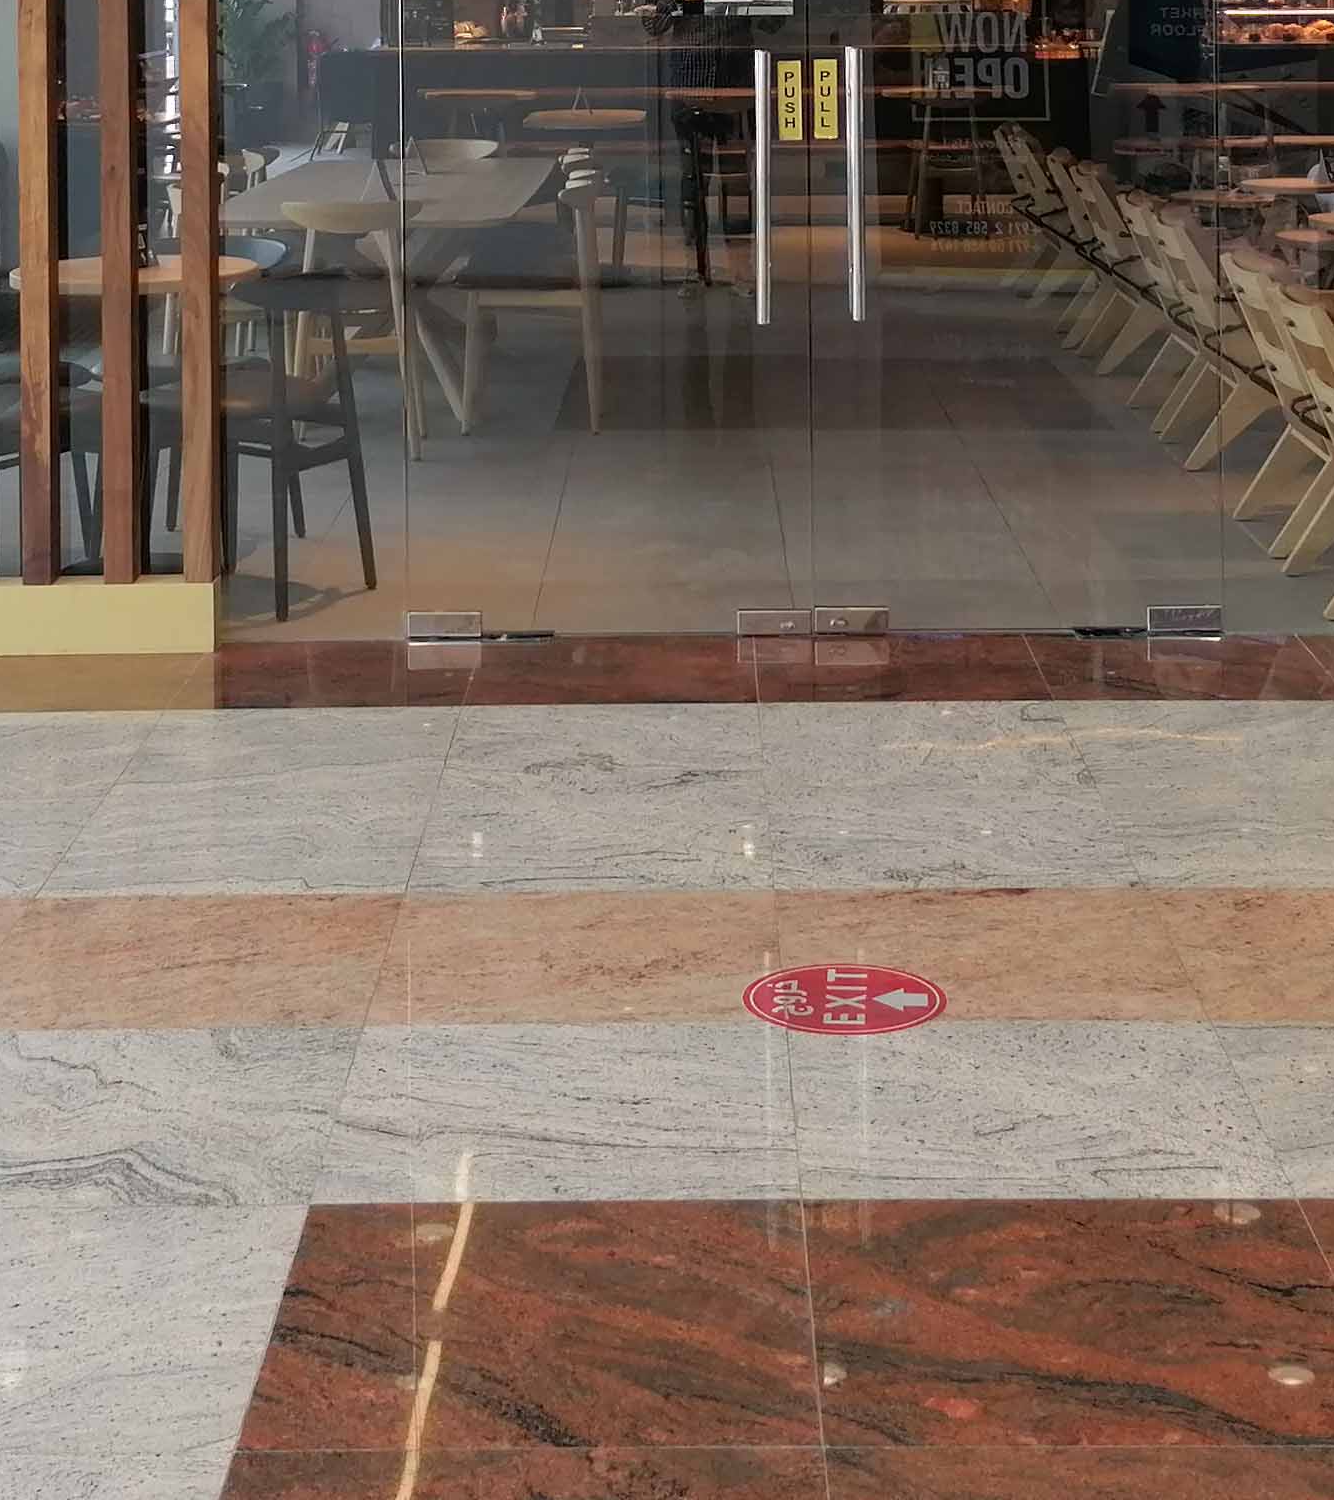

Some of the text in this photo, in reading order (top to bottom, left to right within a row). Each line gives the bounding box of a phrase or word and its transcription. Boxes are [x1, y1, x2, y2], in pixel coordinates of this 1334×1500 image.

[784, 71, 796, 129] PUSH
[819, 70, 831, 128] PULL
[767, 979, 815, 1020] خروج
[823, 969, 868, 1025] EXIT
